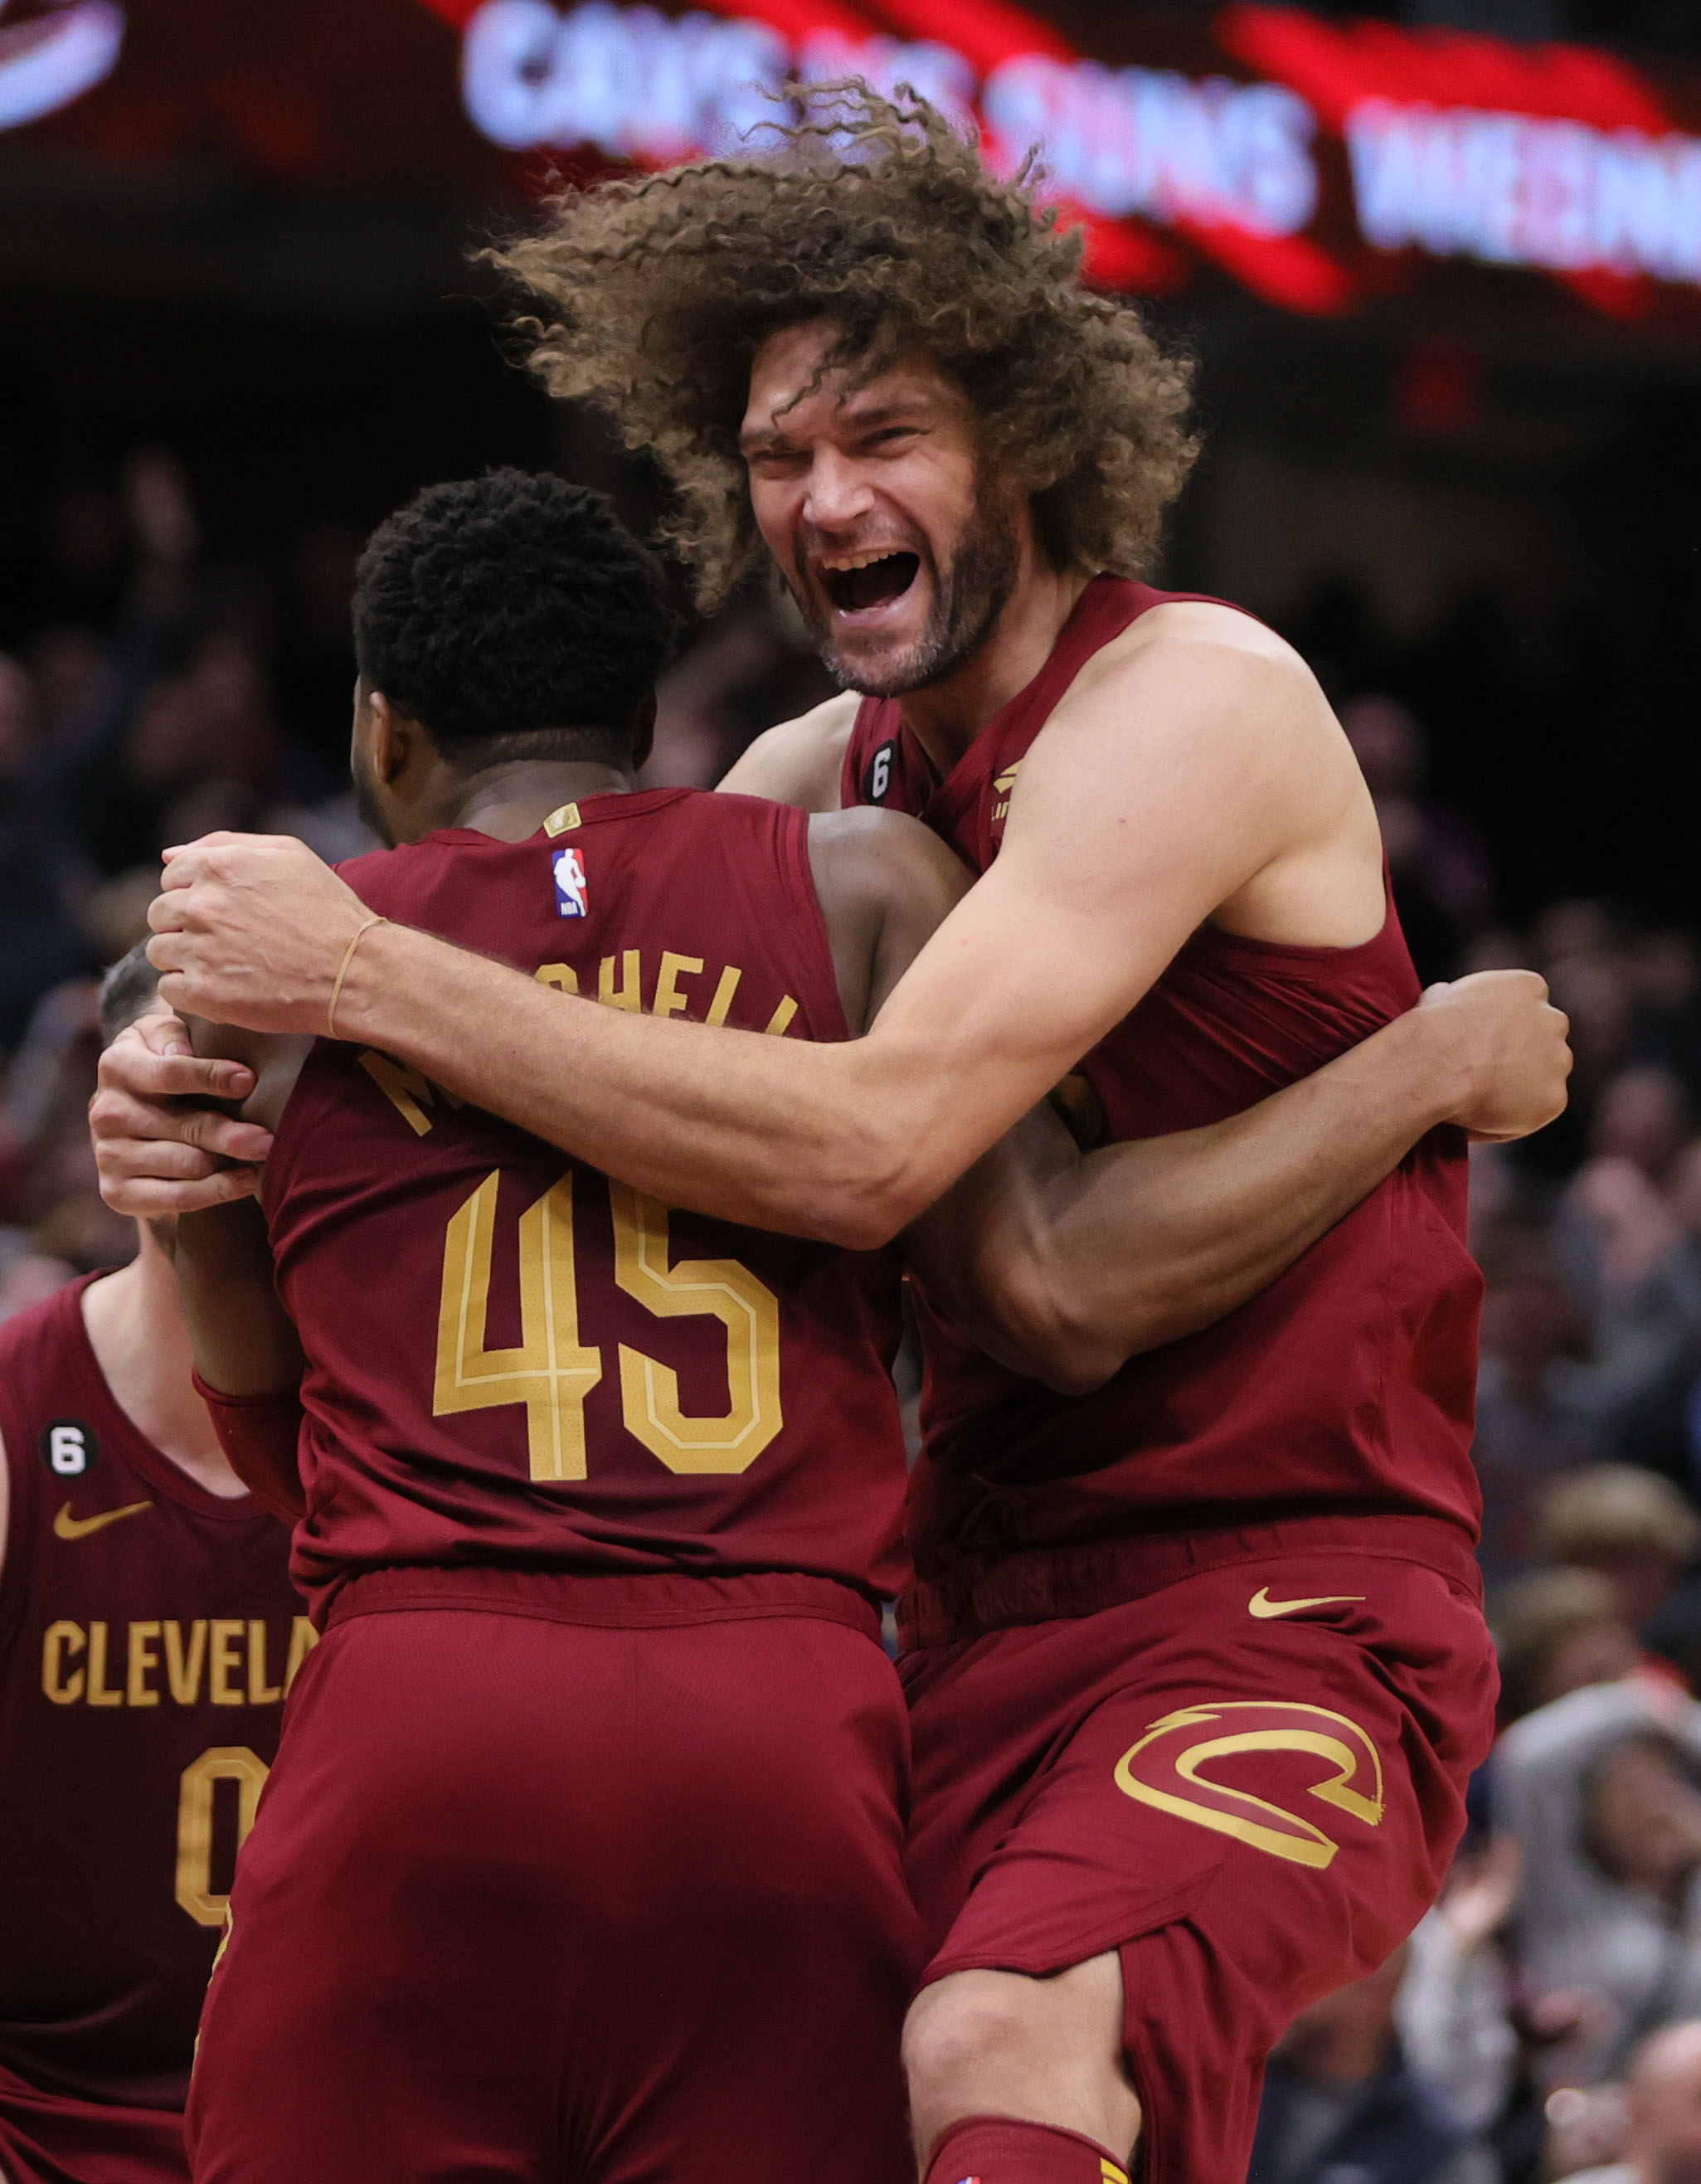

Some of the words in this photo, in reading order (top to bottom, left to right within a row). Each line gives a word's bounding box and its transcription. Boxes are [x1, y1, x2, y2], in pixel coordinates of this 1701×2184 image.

[872, 747, 892, 799] 6
[561, 902, 578, 916] NBA
[432, 1168, 784, 1481] 45
[50, 1427, 86, 1475] 6
